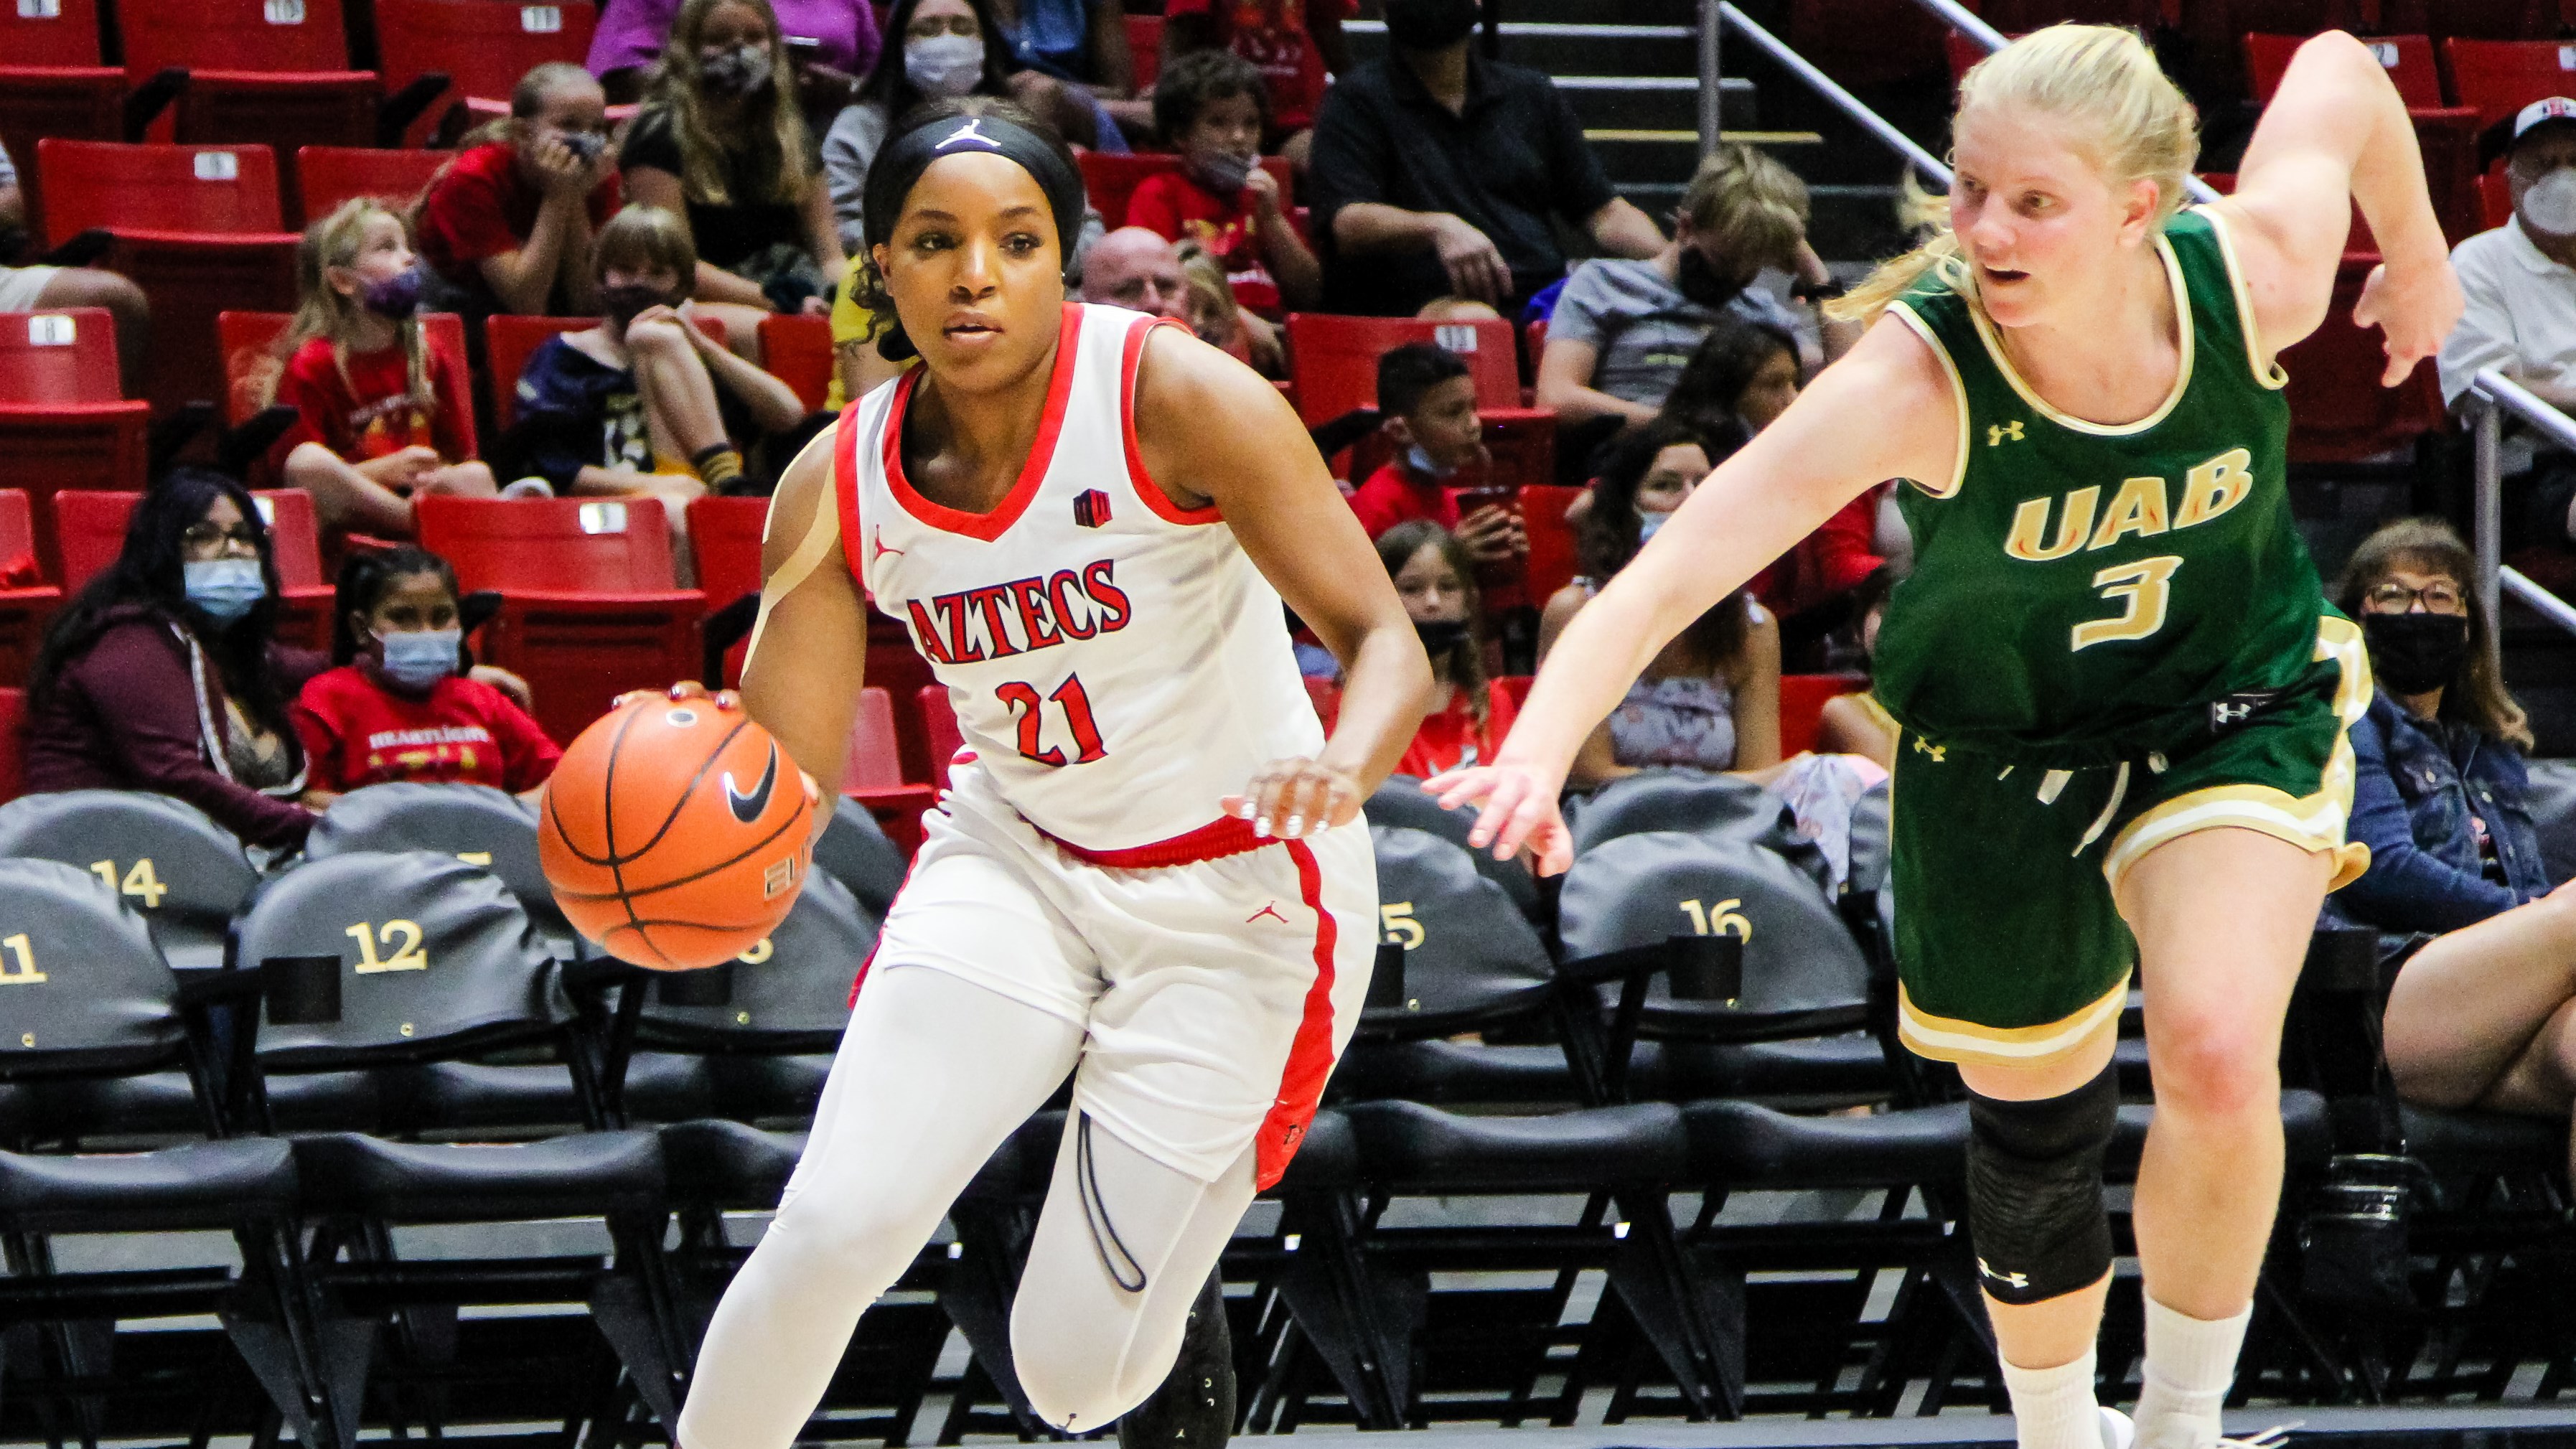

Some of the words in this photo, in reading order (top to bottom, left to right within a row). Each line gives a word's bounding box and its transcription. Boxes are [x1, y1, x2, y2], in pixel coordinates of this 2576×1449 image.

[2005, 447, 2254, 561] UAB
[907, 559, 1132, 665] AZTECS
[2071, 555, 2184, 652] 3
[995, 672, 1108, 767] 21
[90, 858, 169, 908] 14
[345, 918, 428, 975] 12
[1378, 901, 1425, 951] 5
[1680, 897, 1753, 946] 16
[0, 933, 48, 986] 1
